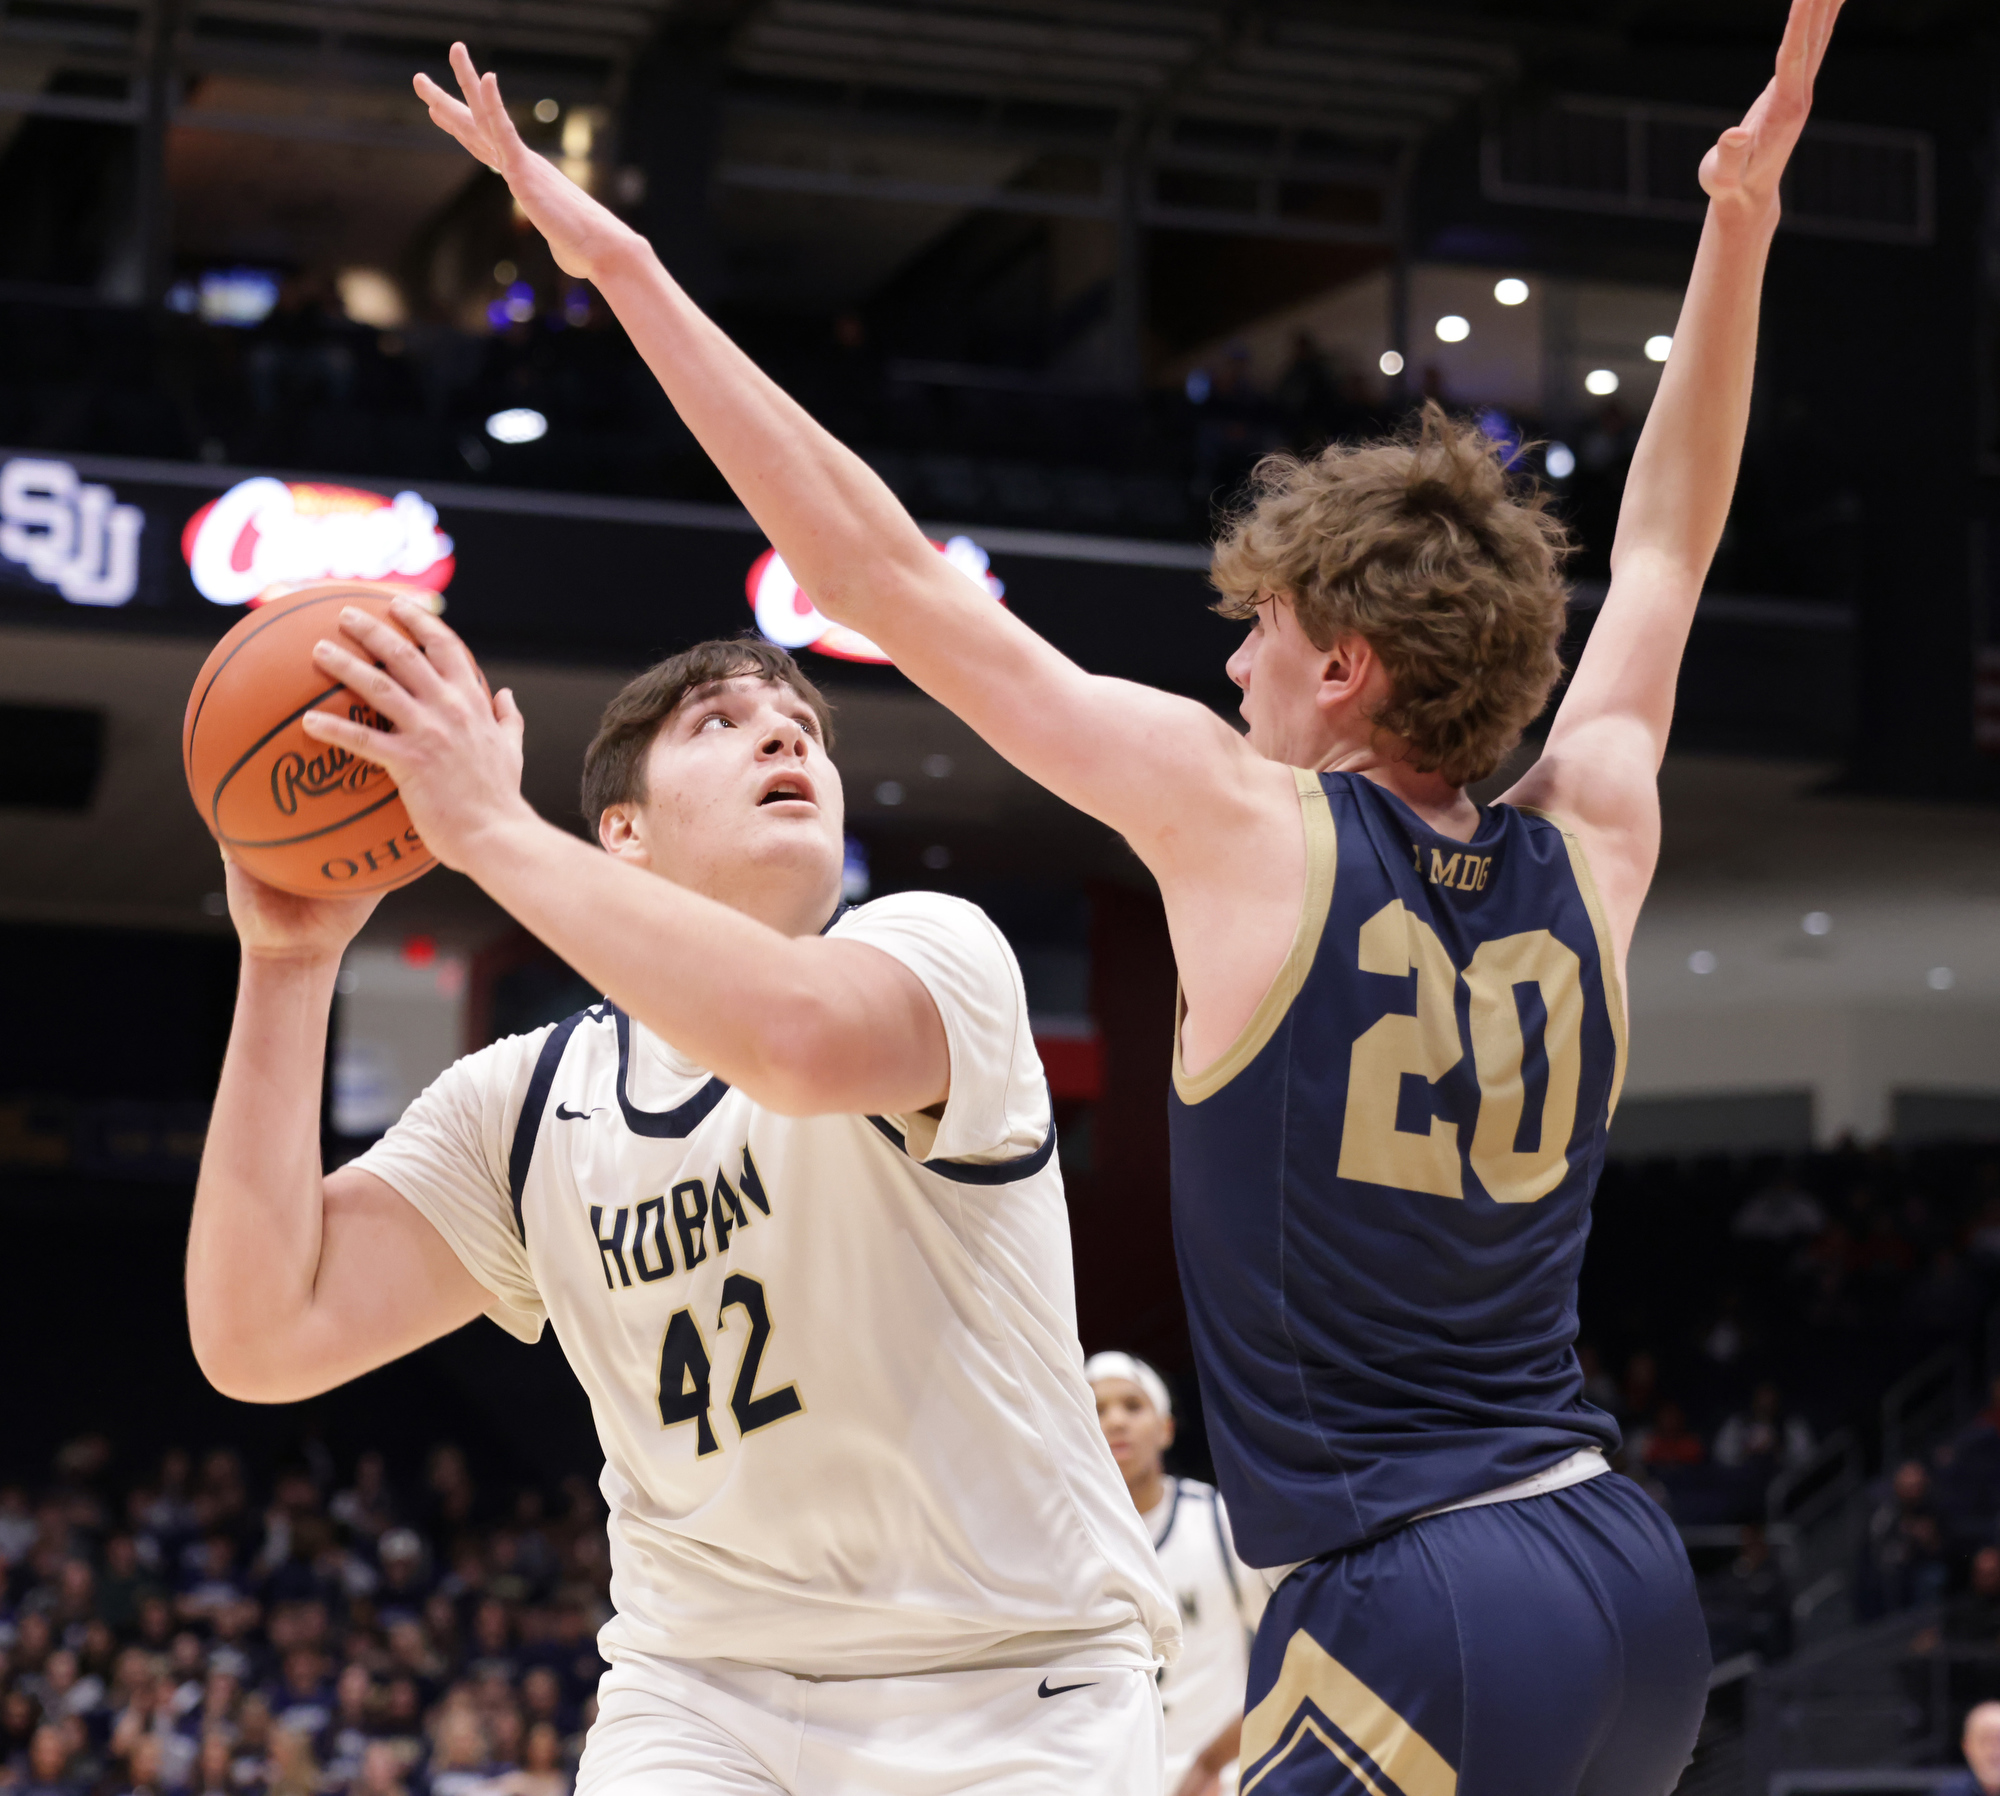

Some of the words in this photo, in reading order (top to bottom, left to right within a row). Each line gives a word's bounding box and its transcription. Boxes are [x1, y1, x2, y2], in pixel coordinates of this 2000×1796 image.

[1336, 897, 1584, 1203] 20
[589, 1143, 772, 1291] HOBAN
[657, 1268, 808, 1461] 42
